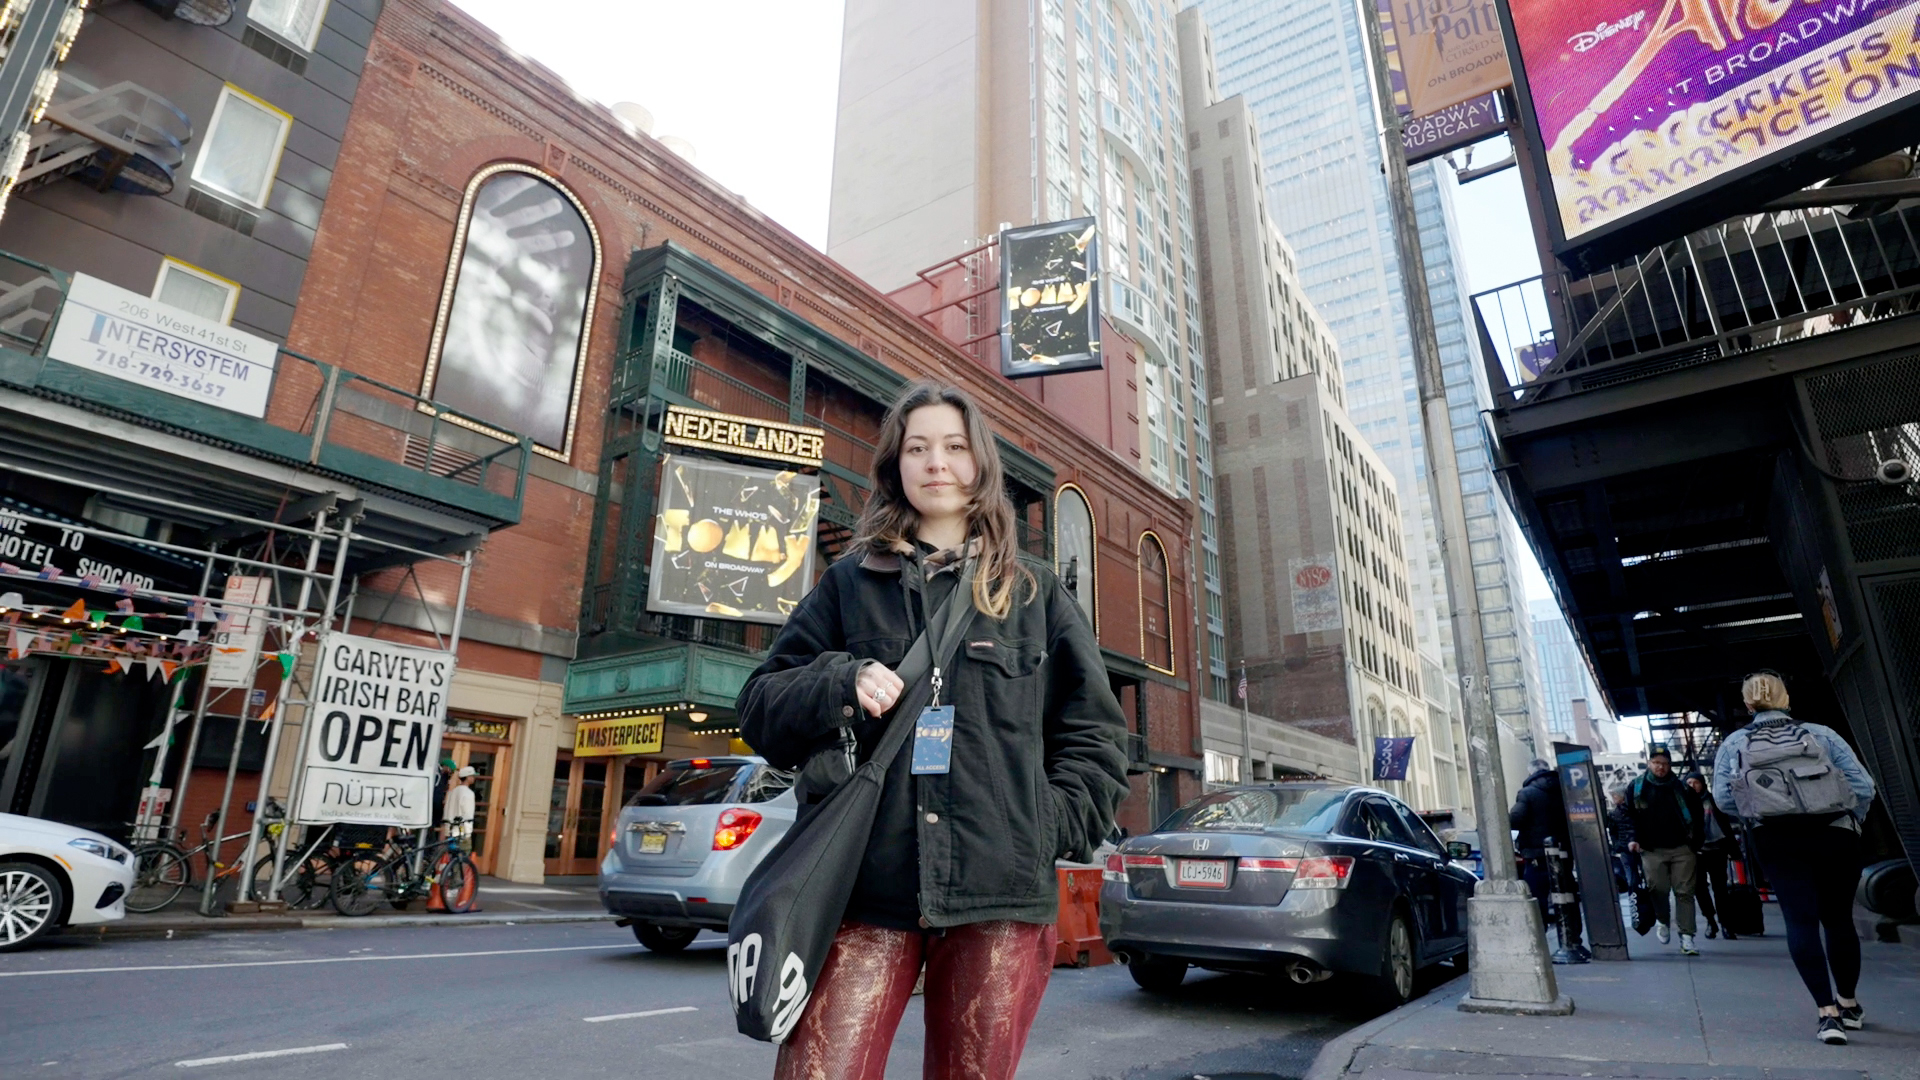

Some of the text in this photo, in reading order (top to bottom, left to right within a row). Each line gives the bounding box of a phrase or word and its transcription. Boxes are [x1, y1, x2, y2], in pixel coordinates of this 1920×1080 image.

[1566, 9, 1645, 52] Disney
[1428, 50, 1506, 88] ON BROADW
[1402, 117, 1480, 149] MUSICAL
[1008, 281, 1091, 315] TOMMY
[81, 310, 250, 382] INTERSYSTEM
[118, 300, 248, 354] 206 West 41st St
[664, 412, 824, 459] NEDERLANDER
[712, 506, 768, 521] THE WHO'S
[60, 527, 85, 552] TO
[664, 508, 810, 588] TOMMY
[704, 560, 766, 574] ON BROADWAY
[334, 644, 445, 687] GARVEY'S
[321, 675, 441, 718] IRISH BAR
[318, 710, 434, 771] OPEN
[1569, 767, 1584, 787] P
